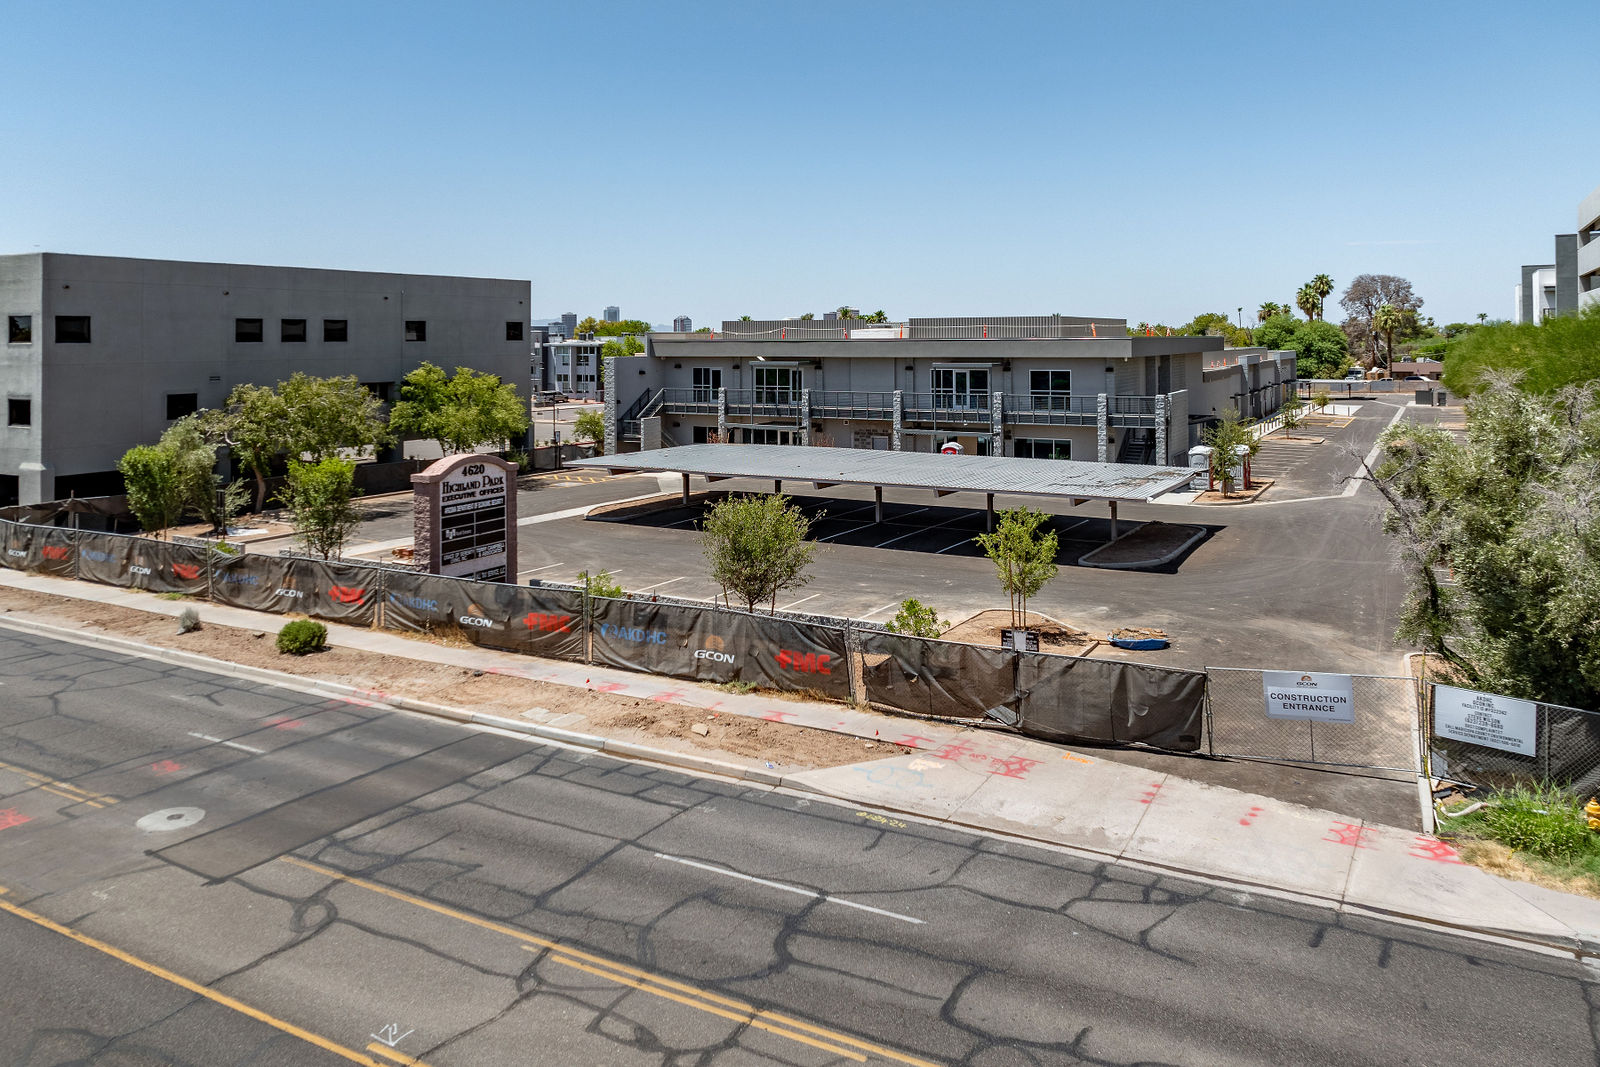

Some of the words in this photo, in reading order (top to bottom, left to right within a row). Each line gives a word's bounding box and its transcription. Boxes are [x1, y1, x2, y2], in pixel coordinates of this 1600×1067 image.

[462, 464, 485, 476] 4620
[442, 481, 480, 494] HIGHLAND
[482, 476, 504, 487] PARK
[442, 491, 476, 502] EXECUTIVE
[479, 486, 504, 496] OFFICES
[8, 549, 27, 558] GCON
[129, 565, 151, 575] GCON
[276, 588, 303, 598] GCON
[459, 615, 493, 628] GCON
[618, 626, 667, 645] AKDHC
[694, 650, 735, 664] GCON
[1270, 693, 1346, 703] CONSTRUCTION
[1283, 702, 1335, 712] ENTRANCE
